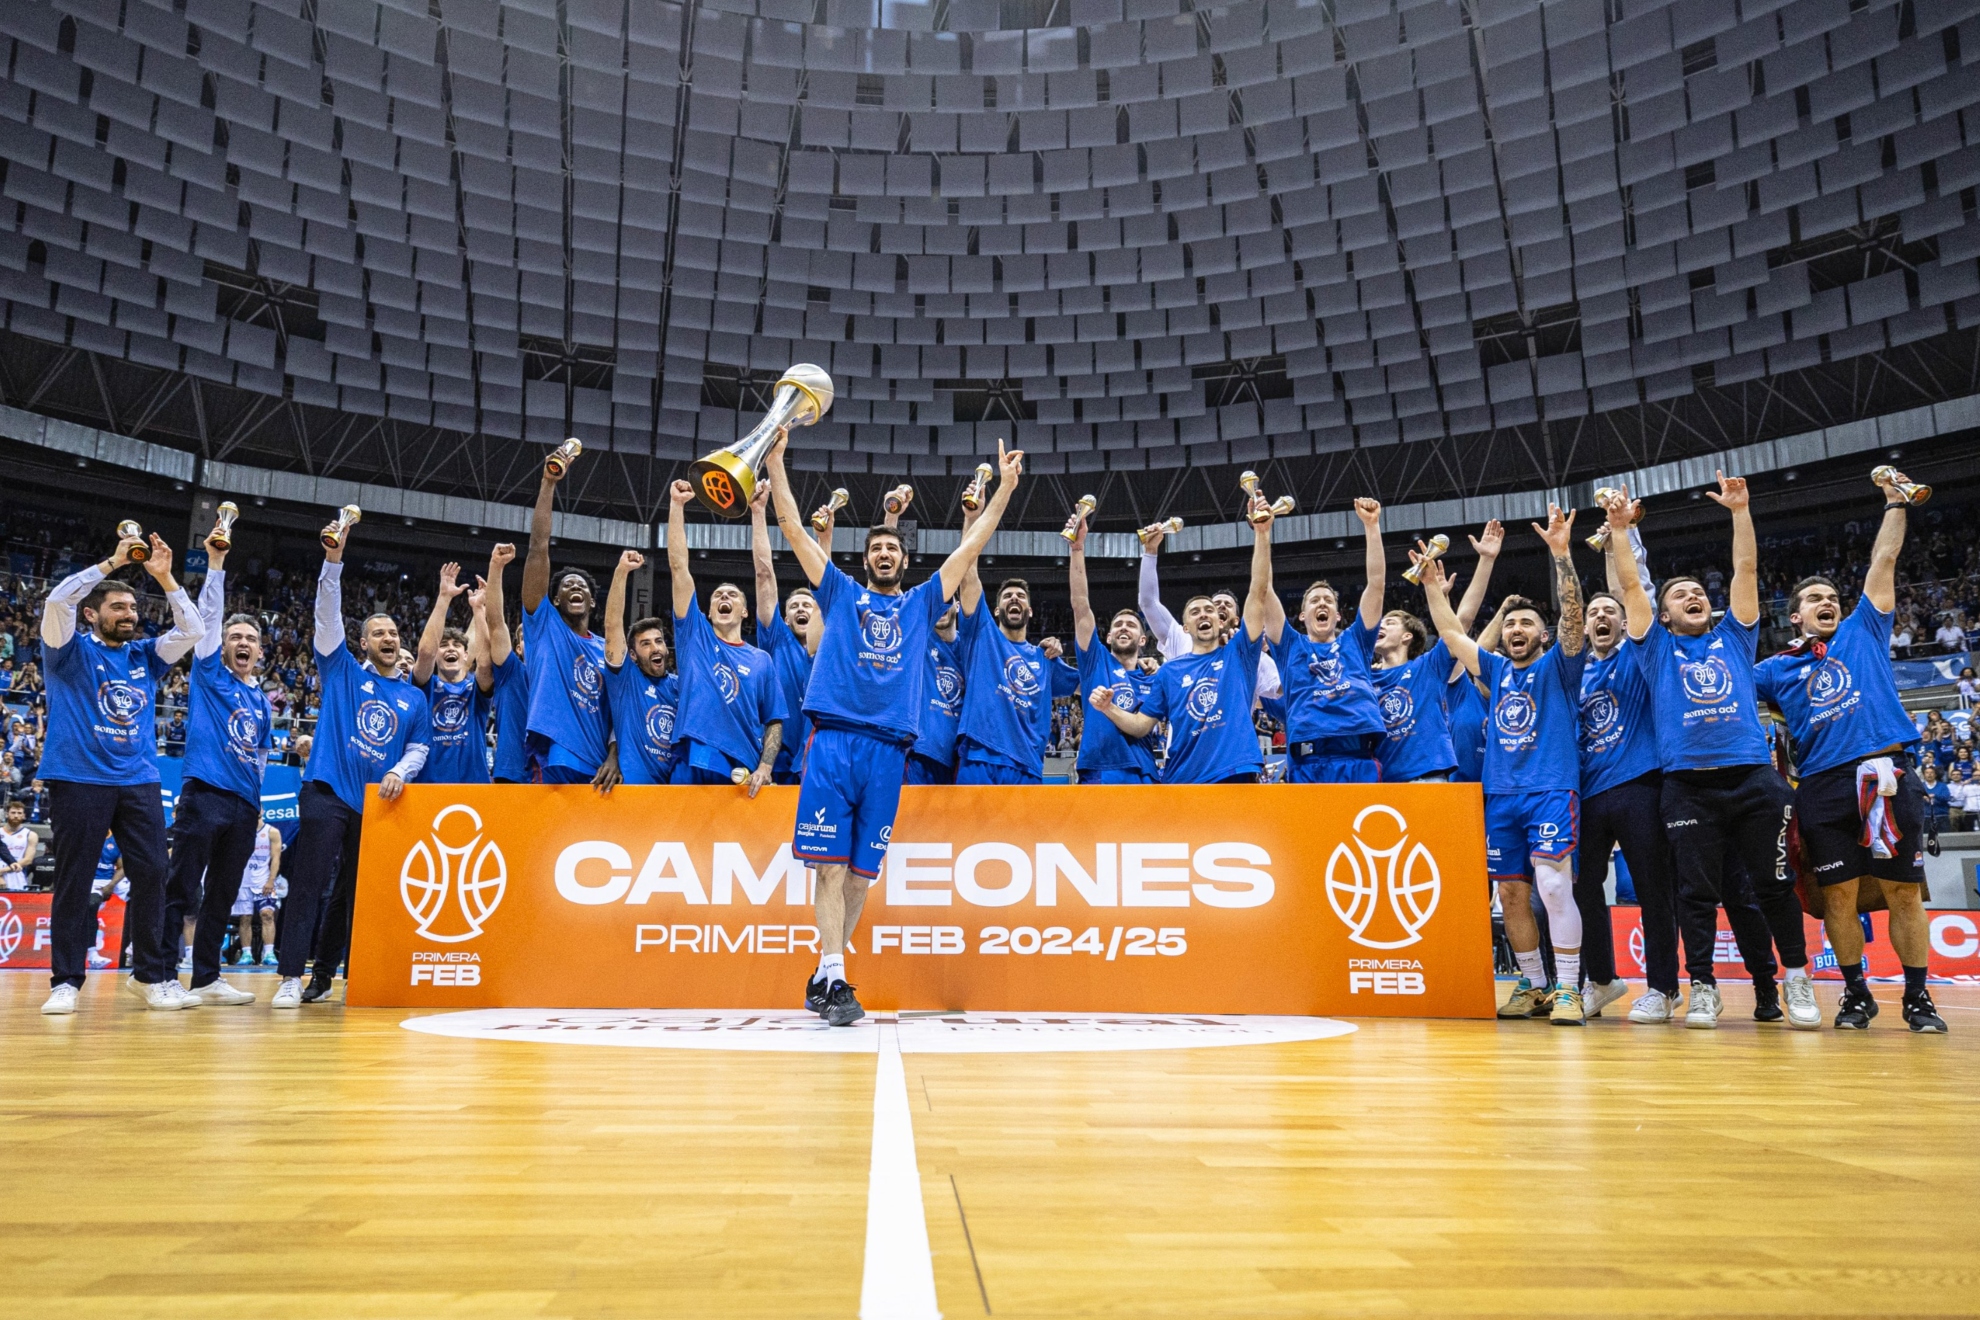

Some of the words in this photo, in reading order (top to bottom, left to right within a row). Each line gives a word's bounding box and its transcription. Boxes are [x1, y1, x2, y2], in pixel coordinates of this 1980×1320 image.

[859, 652, 886, 661] somos
[1684, 708, 1718, 719] somos
[1810, 706, 1841, 724] somos
[94, 724, 127, 735] somos
[350, 736, 372, 752] somos
[798, 822, 837, 833] cajarural
[1776, 804, 1792, 880] GIVOVA
[554, 841, 1276, 908] CAMEONES
[872, 926, 966, 955] FEB
[979, 926, 1188, 961] 2024/25
[412, 952, 481, 962] PRIMERA
[1348, 960, 1424, 970] PRIMERA
[411, 964, 481, 986] FEB
[1350, 972, 1426, 995] FEB
